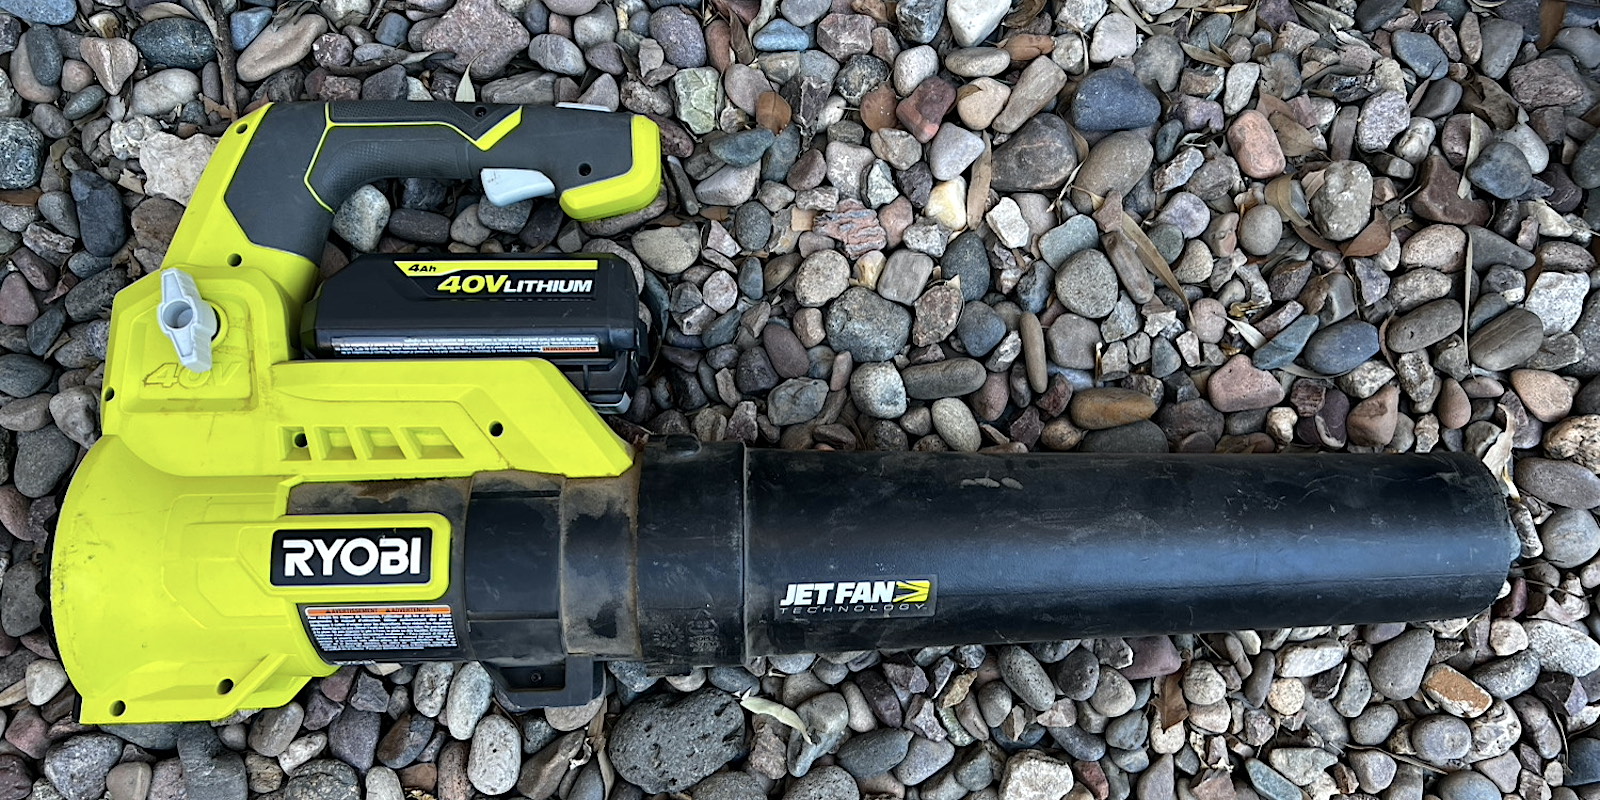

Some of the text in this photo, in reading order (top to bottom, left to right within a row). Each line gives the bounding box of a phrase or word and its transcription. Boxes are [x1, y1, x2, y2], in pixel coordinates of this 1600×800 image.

[407, 263, 437, 273] 4Ah
[143, 362, 243, 389] 40V
[282, 537, 422, 577] RYOBI
[779, 580, 896, 607] JET FAN
[779, 604, 925, 615] TECHNOLOGY
